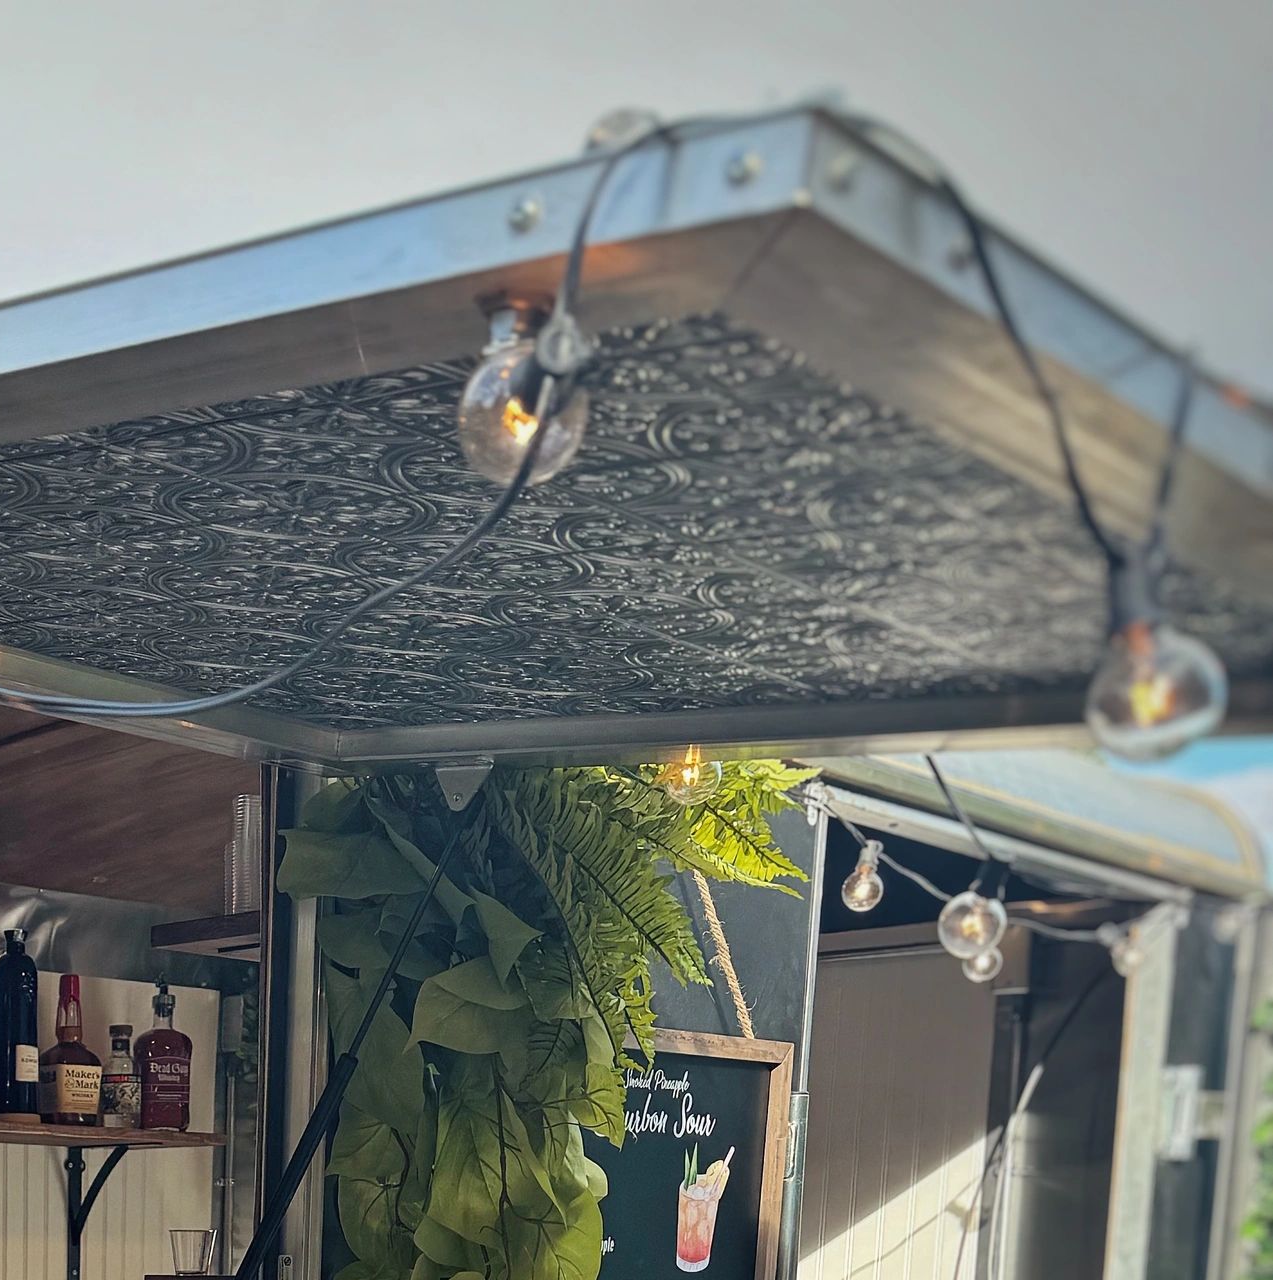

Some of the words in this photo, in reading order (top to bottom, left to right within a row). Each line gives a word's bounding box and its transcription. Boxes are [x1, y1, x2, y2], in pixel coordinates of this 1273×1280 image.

[149, 1062, 171, 1073] Dead
[65, 1069, 100, 1080] Maker's
[75, 1079, 99, 1090] Mark
[624, 1068, 654, 1091] Smoked
[653, 1069, 691, 1099] Pineapple
[624, 1092, 668, 1135] urbon
[673, 1092, 716, 1139] Sour
